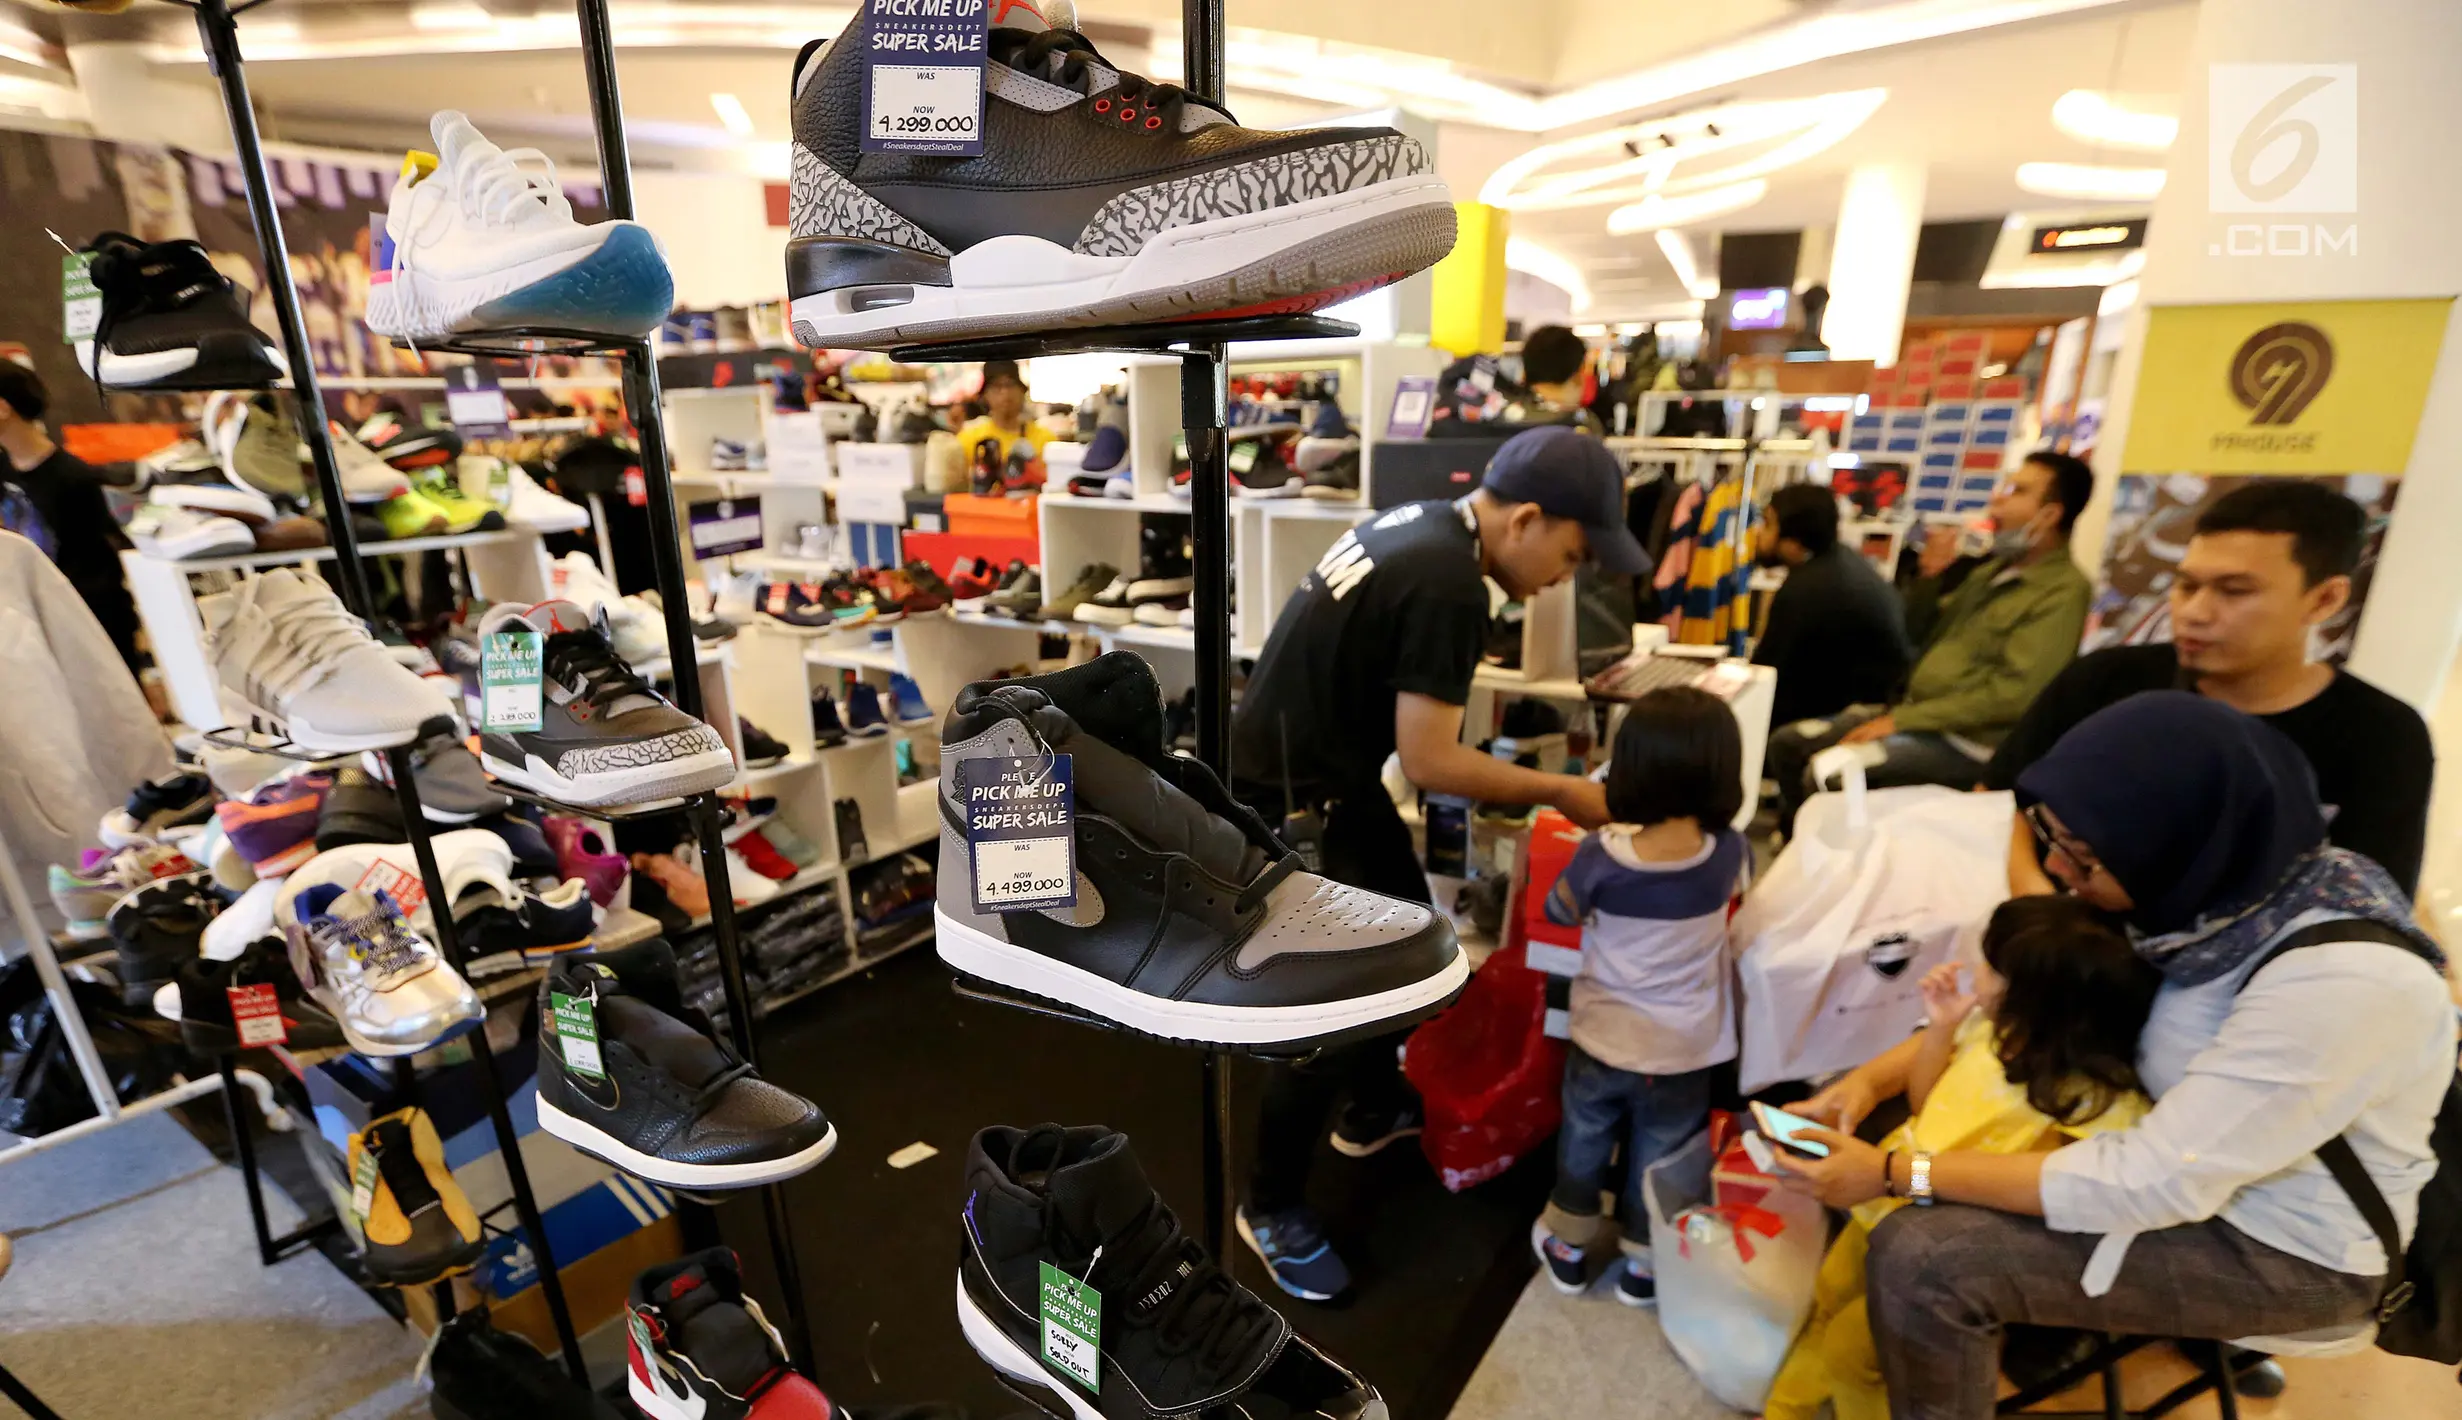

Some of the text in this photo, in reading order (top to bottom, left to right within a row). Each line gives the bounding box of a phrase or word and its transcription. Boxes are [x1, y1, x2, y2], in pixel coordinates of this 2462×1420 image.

[873, 0, 983, 16] PICK ME UP
[875, 22, 980, 31] SNEAKERSDEPT
[872, 32, 982, 53] SUPER SALE
[916, 72, 935, 80] WAS
[913, 106, 935, 114] NOW
[879, 115, 973, 132] 4.299.000
[486, 667, 539, 680] SUPER SALE
[1001, 772, 1036, 783] PLEE
[972, 785, 1011, 801] PICK
[1043, 782, 1066, 797] UP
[974, 802, 1066, 813] SNEAKERSDEPT
[972, 810, 1067, 831] SUPER SALE
[1013, 871, 1033, 879] NOW
[986, 878, 1064, 896] 4.499.000
[1044, 1282, 1097, 1318] PICK ME UP
[1044, 1301, 1097, 1338] SUPER SALE
[1071, 1361, 1090, 1379] OUT
